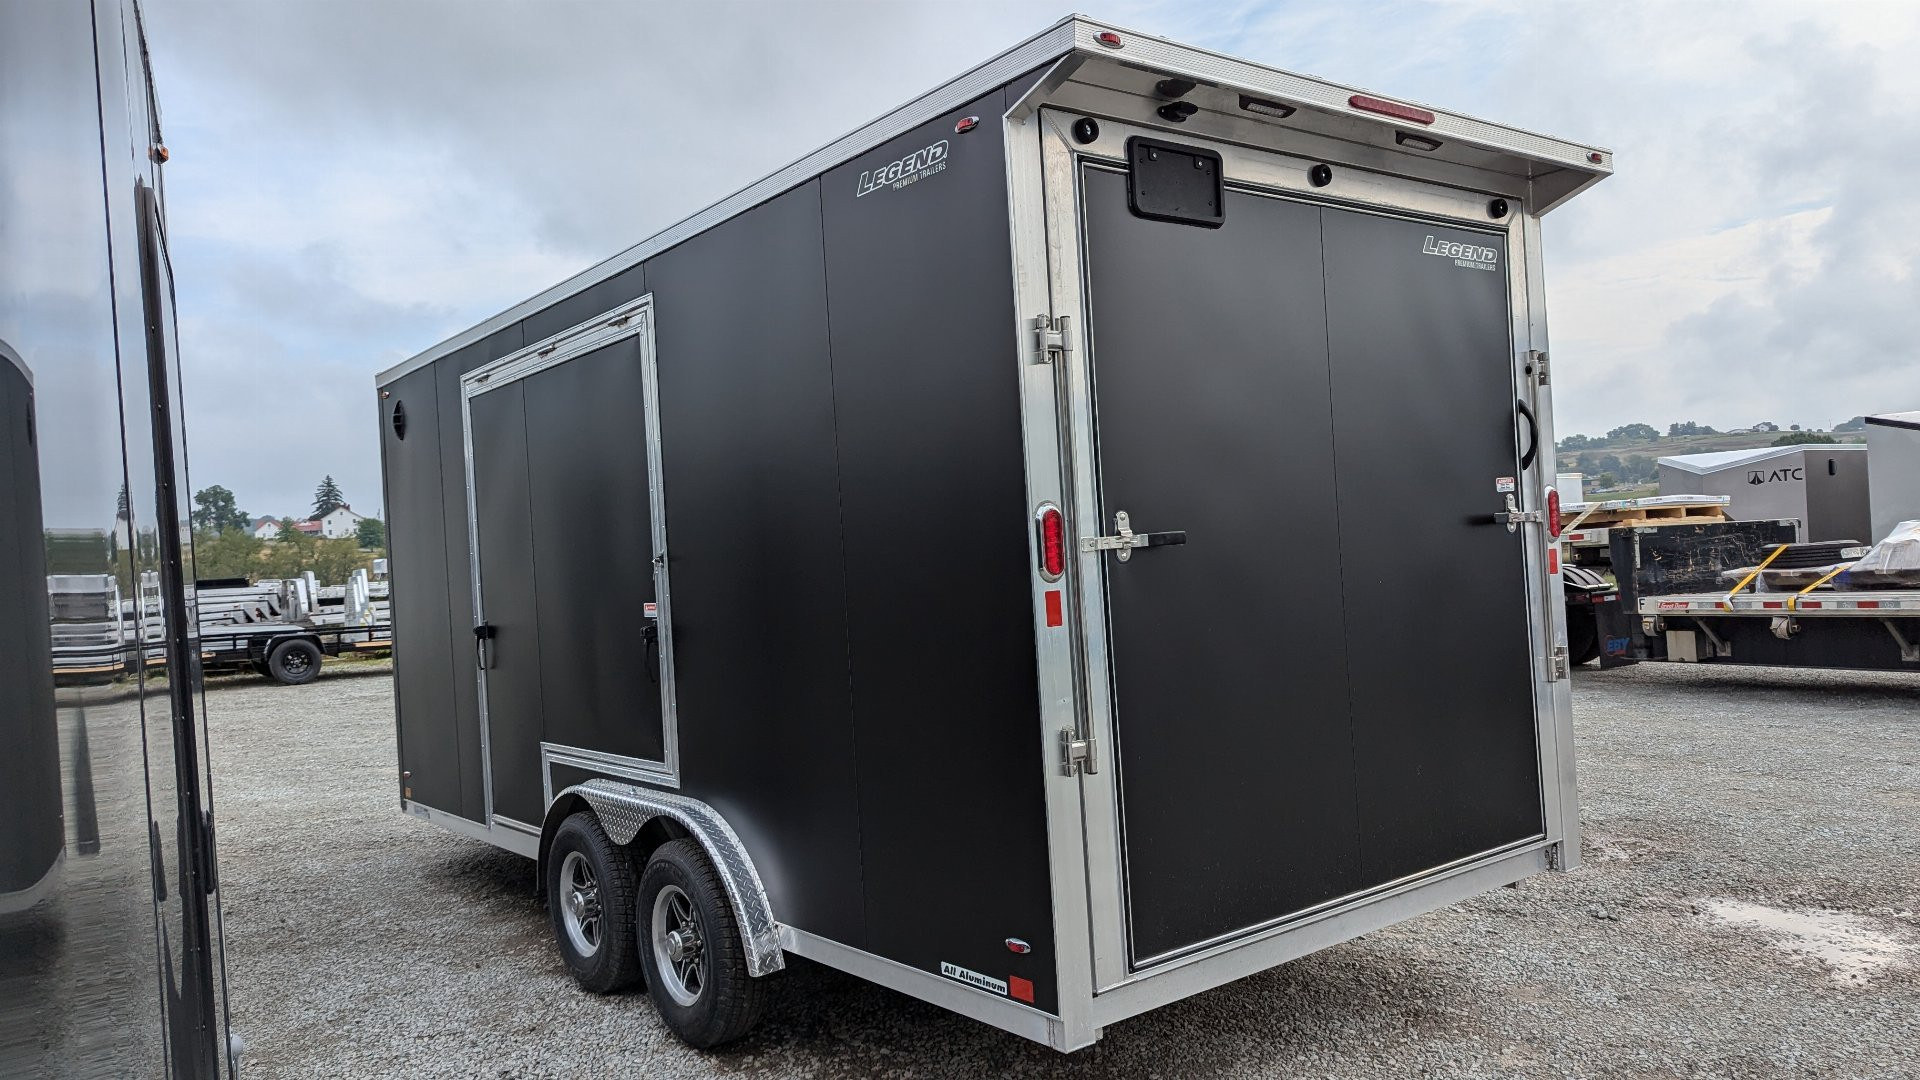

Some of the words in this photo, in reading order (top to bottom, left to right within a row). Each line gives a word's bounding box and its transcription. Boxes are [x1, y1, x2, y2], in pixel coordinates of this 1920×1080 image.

[857, 140, 948, 197] LEGEND
[892, 174, 918, 191] PREMIUM
[919, 161, 946, 180] TRAILERS
[1423, 235, 1497, 263] LEGEND
[1768, 468, 1803, 482] ATC
[944, 965, 956, 976] All
[959, 970, 1006, 993] Aluminum
